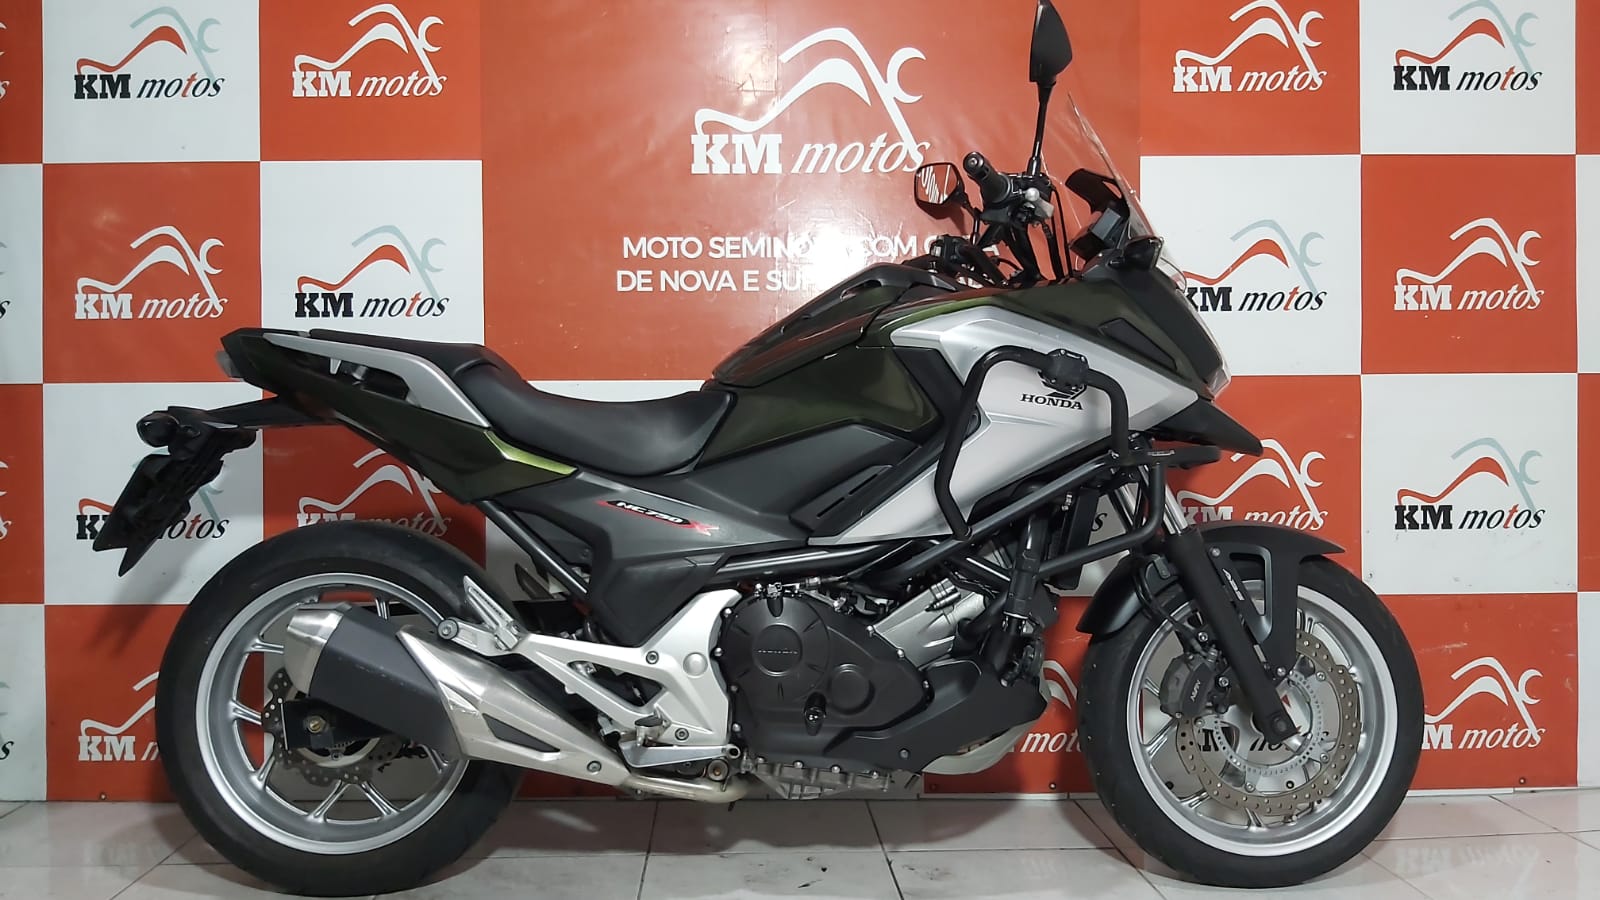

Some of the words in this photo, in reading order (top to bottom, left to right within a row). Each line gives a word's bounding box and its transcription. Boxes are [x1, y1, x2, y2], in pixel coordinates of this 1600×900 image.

[74, 73, 131, 99] KM
[138, 71, 225, 98] motos
[292, 70, 352, 97] KM
[356, 70, 447, 97] motos
[1173, 65, 1232, 92] KM
[1237, 64, 1327, 91] motos
[1393, 65, 1450, 91] KM
[1455, 64, 1542, 91] motos
[691, 133, 783, 174] KM
[791, 131, 931, 174] motos
[623, 236, 703, 258] MOTO
[616, 270, 653, 291] DE
[660, 270, 737, 291] NOVA
[743, 270, 760, 291] E
[75, 293, 132, 319] KM
[139, 292, 228, 318] motos
[295, 293, 353, 318] KM
[360, 292, 449, 317] motos
[1238, 286, 1327, 311] motos
[1394, 284, 1452, 311] KM
[1457, 283, 1544, 310] motos
[1020, 394, 1084, 410] HONDA
[158, 513, 229, 539] otos
[1395, 504, 1452, 530] KM
[1459, 502, 1545, 530] motos
[78, 735, 136, 761] KM
[1458, 722, 1546, 749] motos
